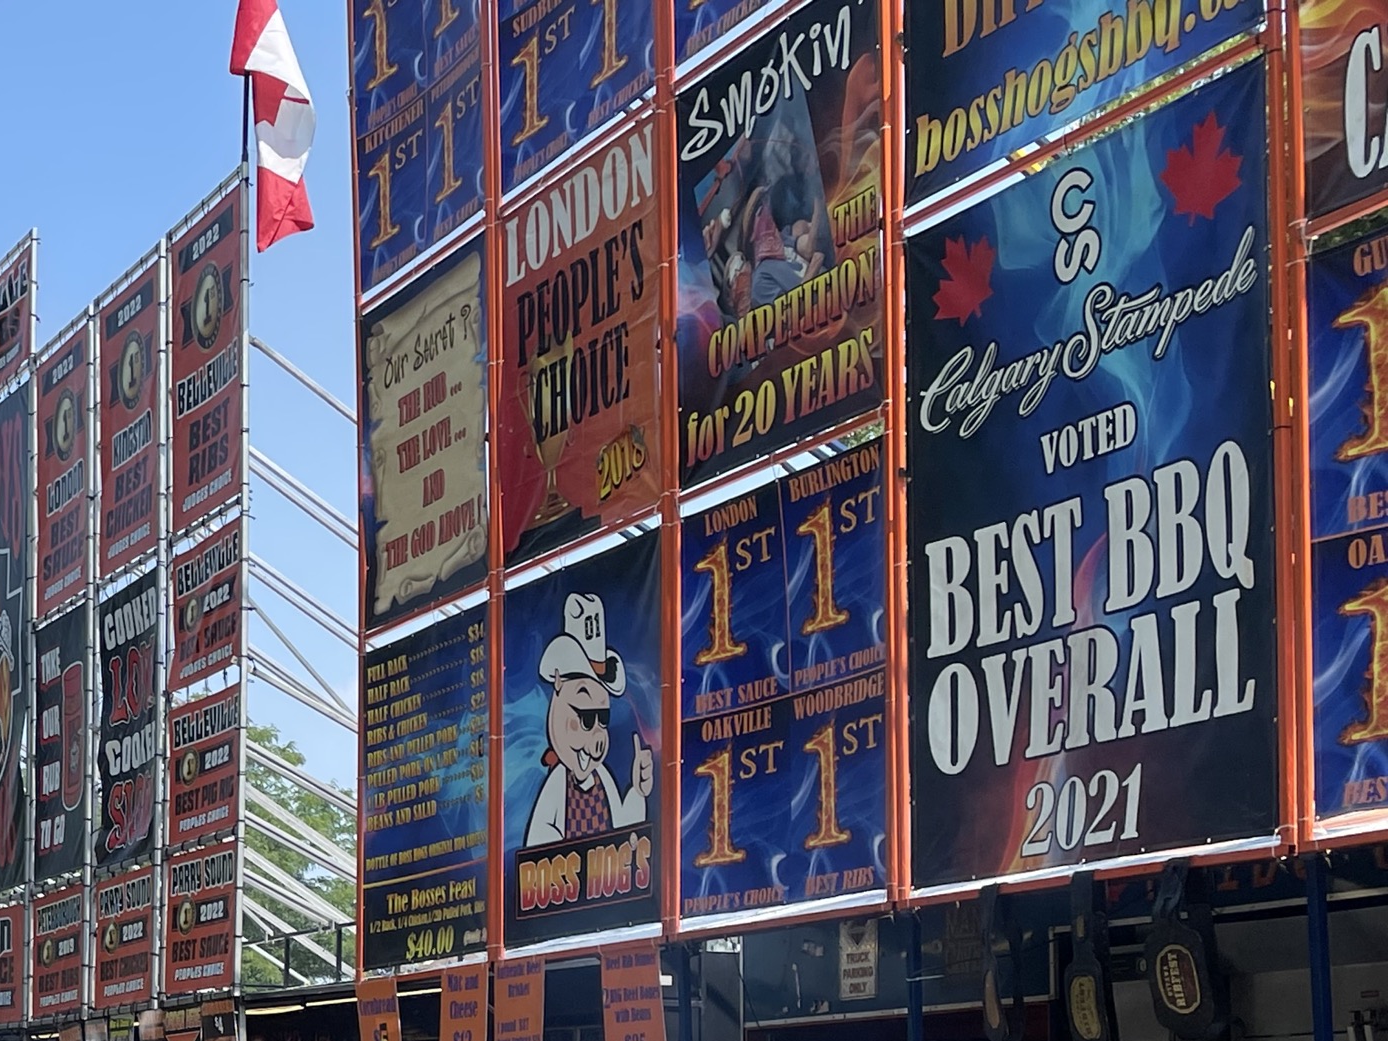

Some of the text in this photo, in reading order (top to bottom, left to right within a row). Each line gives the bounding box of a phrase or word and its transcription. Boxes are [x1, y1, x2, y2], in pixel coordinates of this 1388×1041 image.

[365, 98, 424, 154] KITCHENER
[505, 122, 654, 288] LONDON
[832, 186, 877, 248] THE
[192, 222, 220, 262] 2022
[117, 294, 143, 328] 2022
[516, 219, 644, 369] PEOPLE'S
[707, 246, 877, 379] COMPETITION
[383, 351, 409, 389] Our
[413, 312, 455, 371] Secret
[919, 226, 1259, 439] Calgary Stampede
[176, 335, 239, 420] BELLEVILLE
[534, 321, 630, 445] CHOICE
[686, 327, 874, 468] for 20 YEARS
[398, 370, 447, 428] THE RUB
[112, 407, 152, 472] KINGSTON
[188, 396, 230, 450] BEST
[1040, 402, 1137, 474] VOTED
[188, 433, 229, 487] RIBS
[397, 416, 452, 474] THE LOVE
[46, 457, 85, 518] LONDON
[114, 454, 150, 505] BEST
[422, 468, 445, 508] AND
[788, 443, 880, 503] BURLINGTON
[50, 504, 81, 547] BEST
[106, 483, 153, 539] CHICKEN
[704, 496, 758, 537] LONDON
[42, 528, 85, 582] SAUCE
[176, 528, 239, 600] BELLEVILLE
[386, 533, 408, 571] THE
[411, 520, 435, 561] GOD
[925, 440, 1255, 659] BEST BBQ
[104, 585, 157, 651] COOKED
[202, 582, 230, 614] 2022
[203, 611, 237, 649] SAUCE
[584, 614, 602, 642] 01
[40, 646, 61, 686] TAKE
[207, 642, 233, 671] CHOICE
[367, 654, 409, 684] FULL RACK
[794, 655, 847, 688] PEOPLE'S
[367, 675, 411, 705] HALF RACK
[695, 675, 779, 714] BEST SAUCE
[793, 671, 884, 721] WOODBRIDGE
[928, 588, 1256, 775] OVERALL
[42, 704, 60, 741] OUR
[173, 693, 240, 751] BELLEVILLE
[367, 692, 423, 726] HALF CHICKEN
[701, 706, 772, 743] OAKVILLE
[367, 726, 388, 748] RIBS
[396, 711, 428, 736] CHICKEN
[204, 745, 230, 770] 2022
[42, 760, 61, 798] RUB
[367, 768, 398, 789] PULLED
[387, 782, 417, 806] PULLED
[418, 775, 442, 798] PORK
[175, 786, 201, 816] BEST
[367, 800, 437, 832] BEANS AND SALAD
[1021, 763, 1143, 858] 2021
[40, 818, 51, 850] TO
[125, 873, 152, 912] SOUND
[171, 850, 235, 897] PARRY SOUND
[518, 838, 653, 912] BOSS HOG'S
[805, 865, 875, 897] BEST RIBS
[199, 900, 224, 921] 2022
[386, 891, 409, 915] The
[411, 884, 447, 911] Bosses
[449, 876, 477, 901] Feast
[122, 921, 143, 942] 2022
[172, 932, 229, 963] BEST SAUCE
[405, 924, 455, 961] $40.00
[100, 959, 119, 982] BEST
[174, 961, 225, 982] PEOPLES CHOICE
[842, 966, 874, 980] PARKING
[846, 951, 871, 964] TRUCK
[848, 982, 868, 995] ONLY
[1167, 952, 1187, 1008] RIBFEST
[450, 1000, 478, 1020] Cheese
